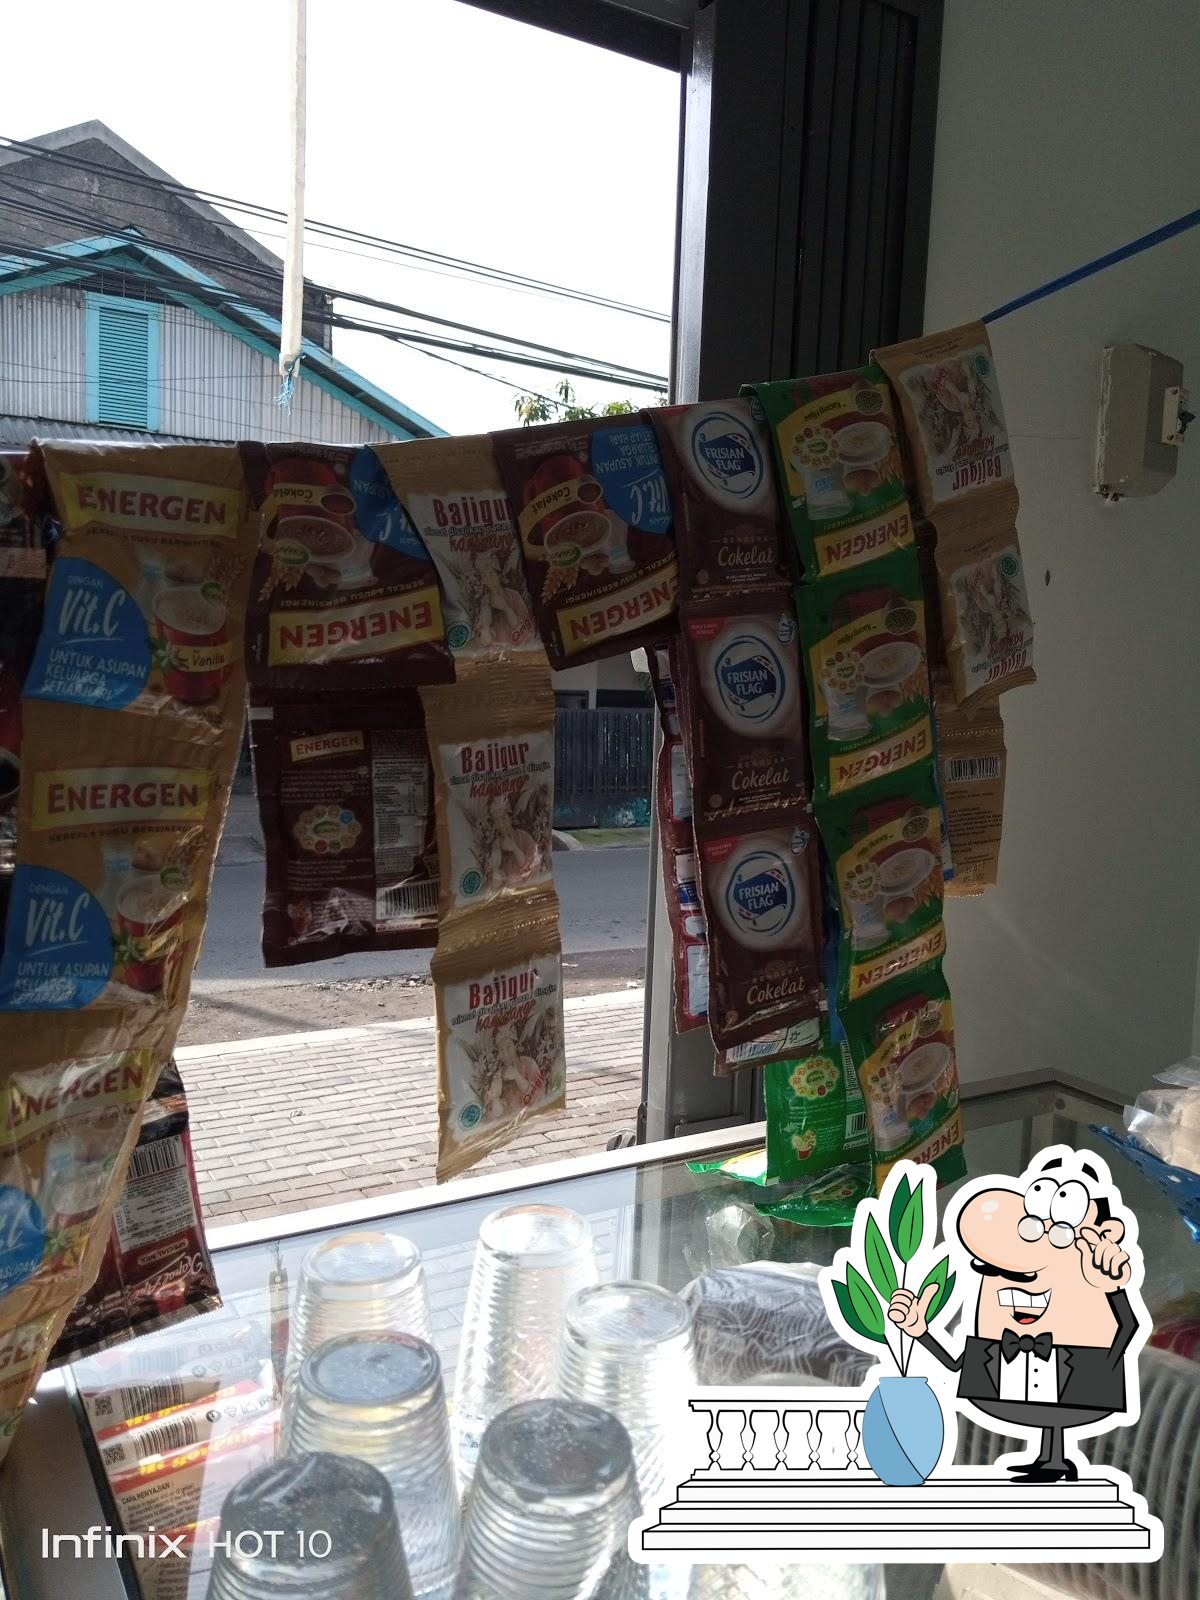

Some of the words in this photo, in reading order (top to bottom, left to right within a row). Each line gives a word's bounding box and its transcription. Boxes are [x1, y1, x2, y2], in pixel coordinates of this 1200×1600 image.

[704, 446, 745, 460] FRISIAN
[715, 457, 742, 471] FLAG
[76, 483, 227, 526] ENERGEN
[532, 486, 571, 515] Cokelat
[826, 516, 909, 564] ENERGEN
[717, 545, 775, 567] Cokelat
[58, 588, 126, 637] Vit.C
[280, 601, 433, 649] ENERGEN
[45, 663, 107, 684] KELUARGA
[49, 648, 95, 670] UNTUK
[96, 657, 147, 679] ASUPAN
[727, 669, 768, 684] FRISIAN
[735, 681, 763, 695] FLAG
[296, 736, 360, 755] ENERGEN
[838, 729, 927, 782] ENERGEN
[461, 742, 530, 775] Bajigur
[731, 766, 791, 791] Cokelat
[47, 783, 200, 815] ENERGEN
[29, 883, 69, 895] DENGAN
[738, 881, 780, 900] FRISIAN
[746, 893, 774, 911] FLAG
[25, 892, 91, 947] Vit.C
[18, 961, 60, 976] UNTUK
[63, 962, 110, 978] ASUPAN
[468, 968, 539, 1011] Bajigur
[745, 976, 806, 1006] Cokelat
[121, 1494, 137, 1505] CARA
